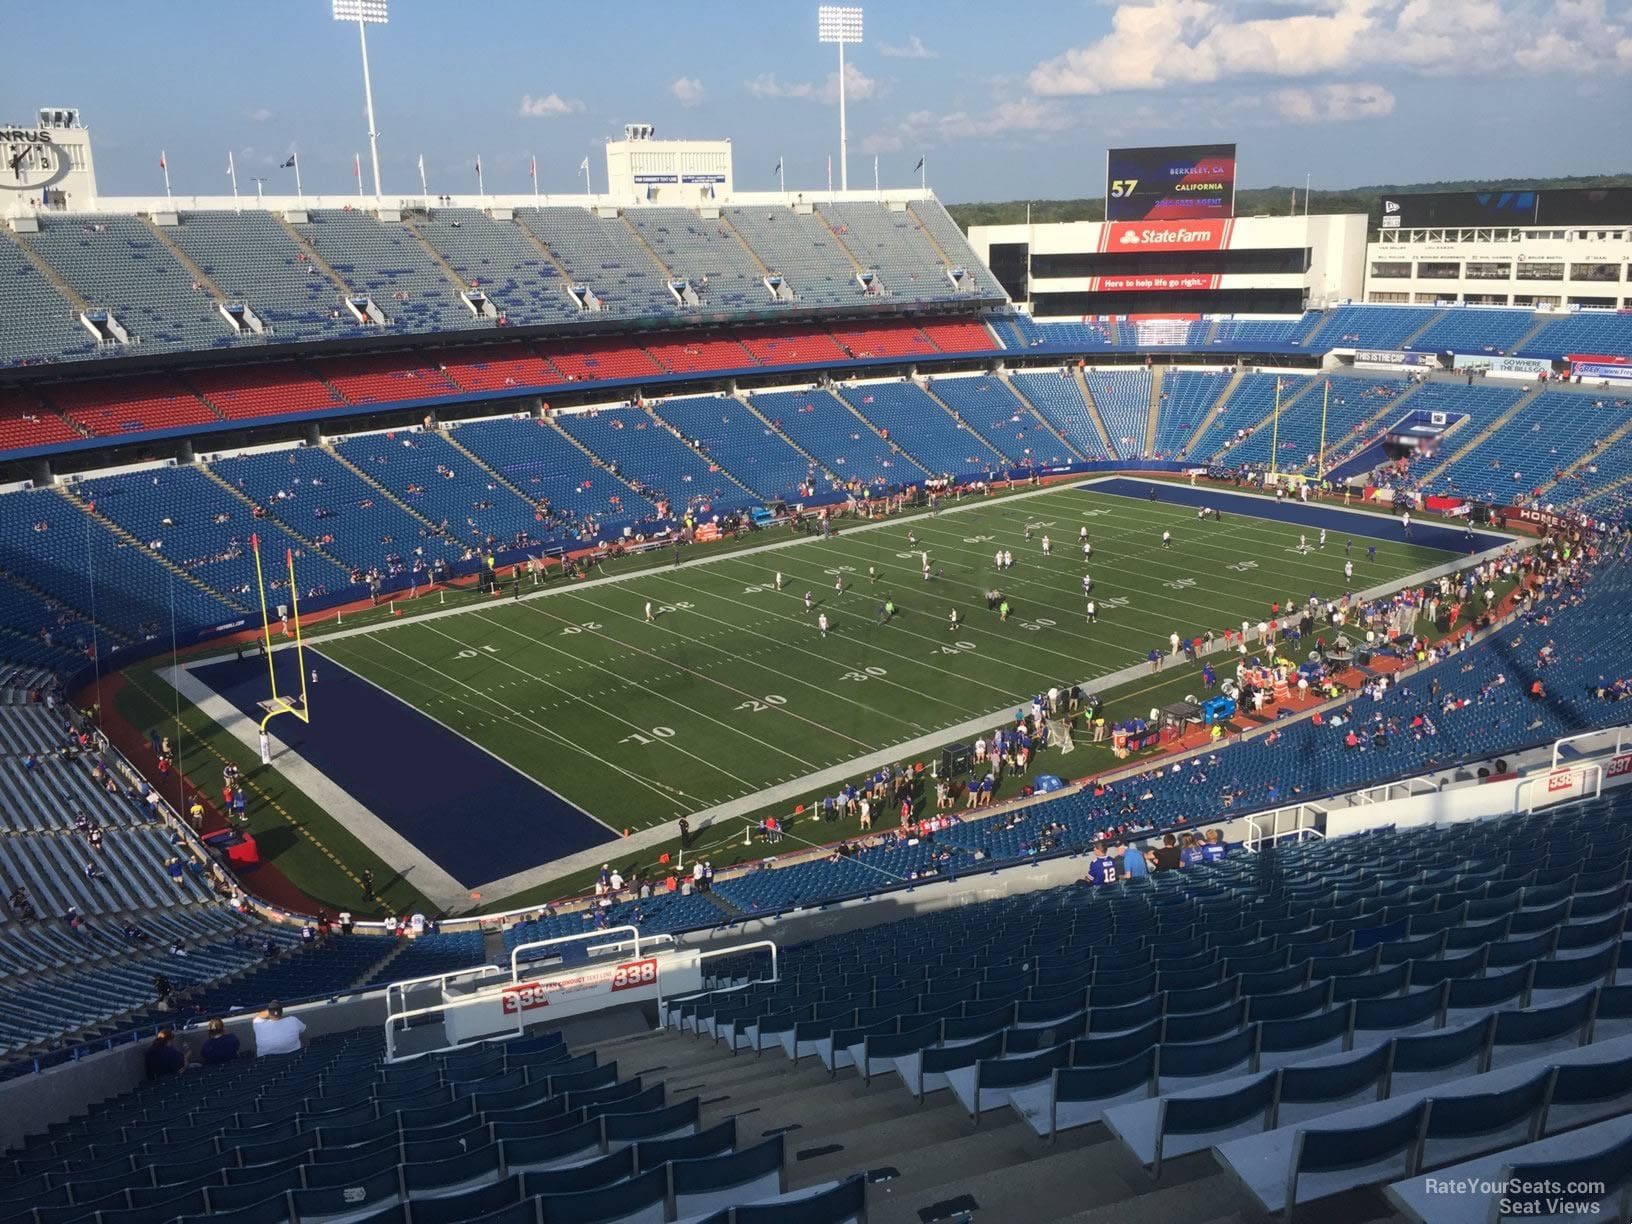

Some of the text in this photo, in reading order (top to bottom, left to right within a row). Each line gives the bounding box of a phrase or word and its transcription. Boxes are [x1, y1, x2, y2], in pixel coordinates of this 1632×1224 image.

[1212, 166, 1224, 174] CA
[1111, 179, 1138, 198] 57
[1175, 183, 1223, 191] CALIFORNIA
[1104, 279, 1123, 288] Here
[1126, 279, 1134, 287] to
[1135, 278, 1152, 289] help
[1154, 277, 1167, 287] life
[1169, 279, 1179, 288] go
[1520, 509, 1559, 526] HOME
[1020, 618, 1056, 631] 50
[942, 641, 976, 655] 40
[844, 666, 887, 682] 30
[741, 694, 787, 712] 20
[627, 726, 676, 745] 10
[1609, 757, 1632, 774] 337
[1103, 867, 1116, 883] 12
[614, 963, 655, 987] 338
[503, 987, 545, 1009] 339
